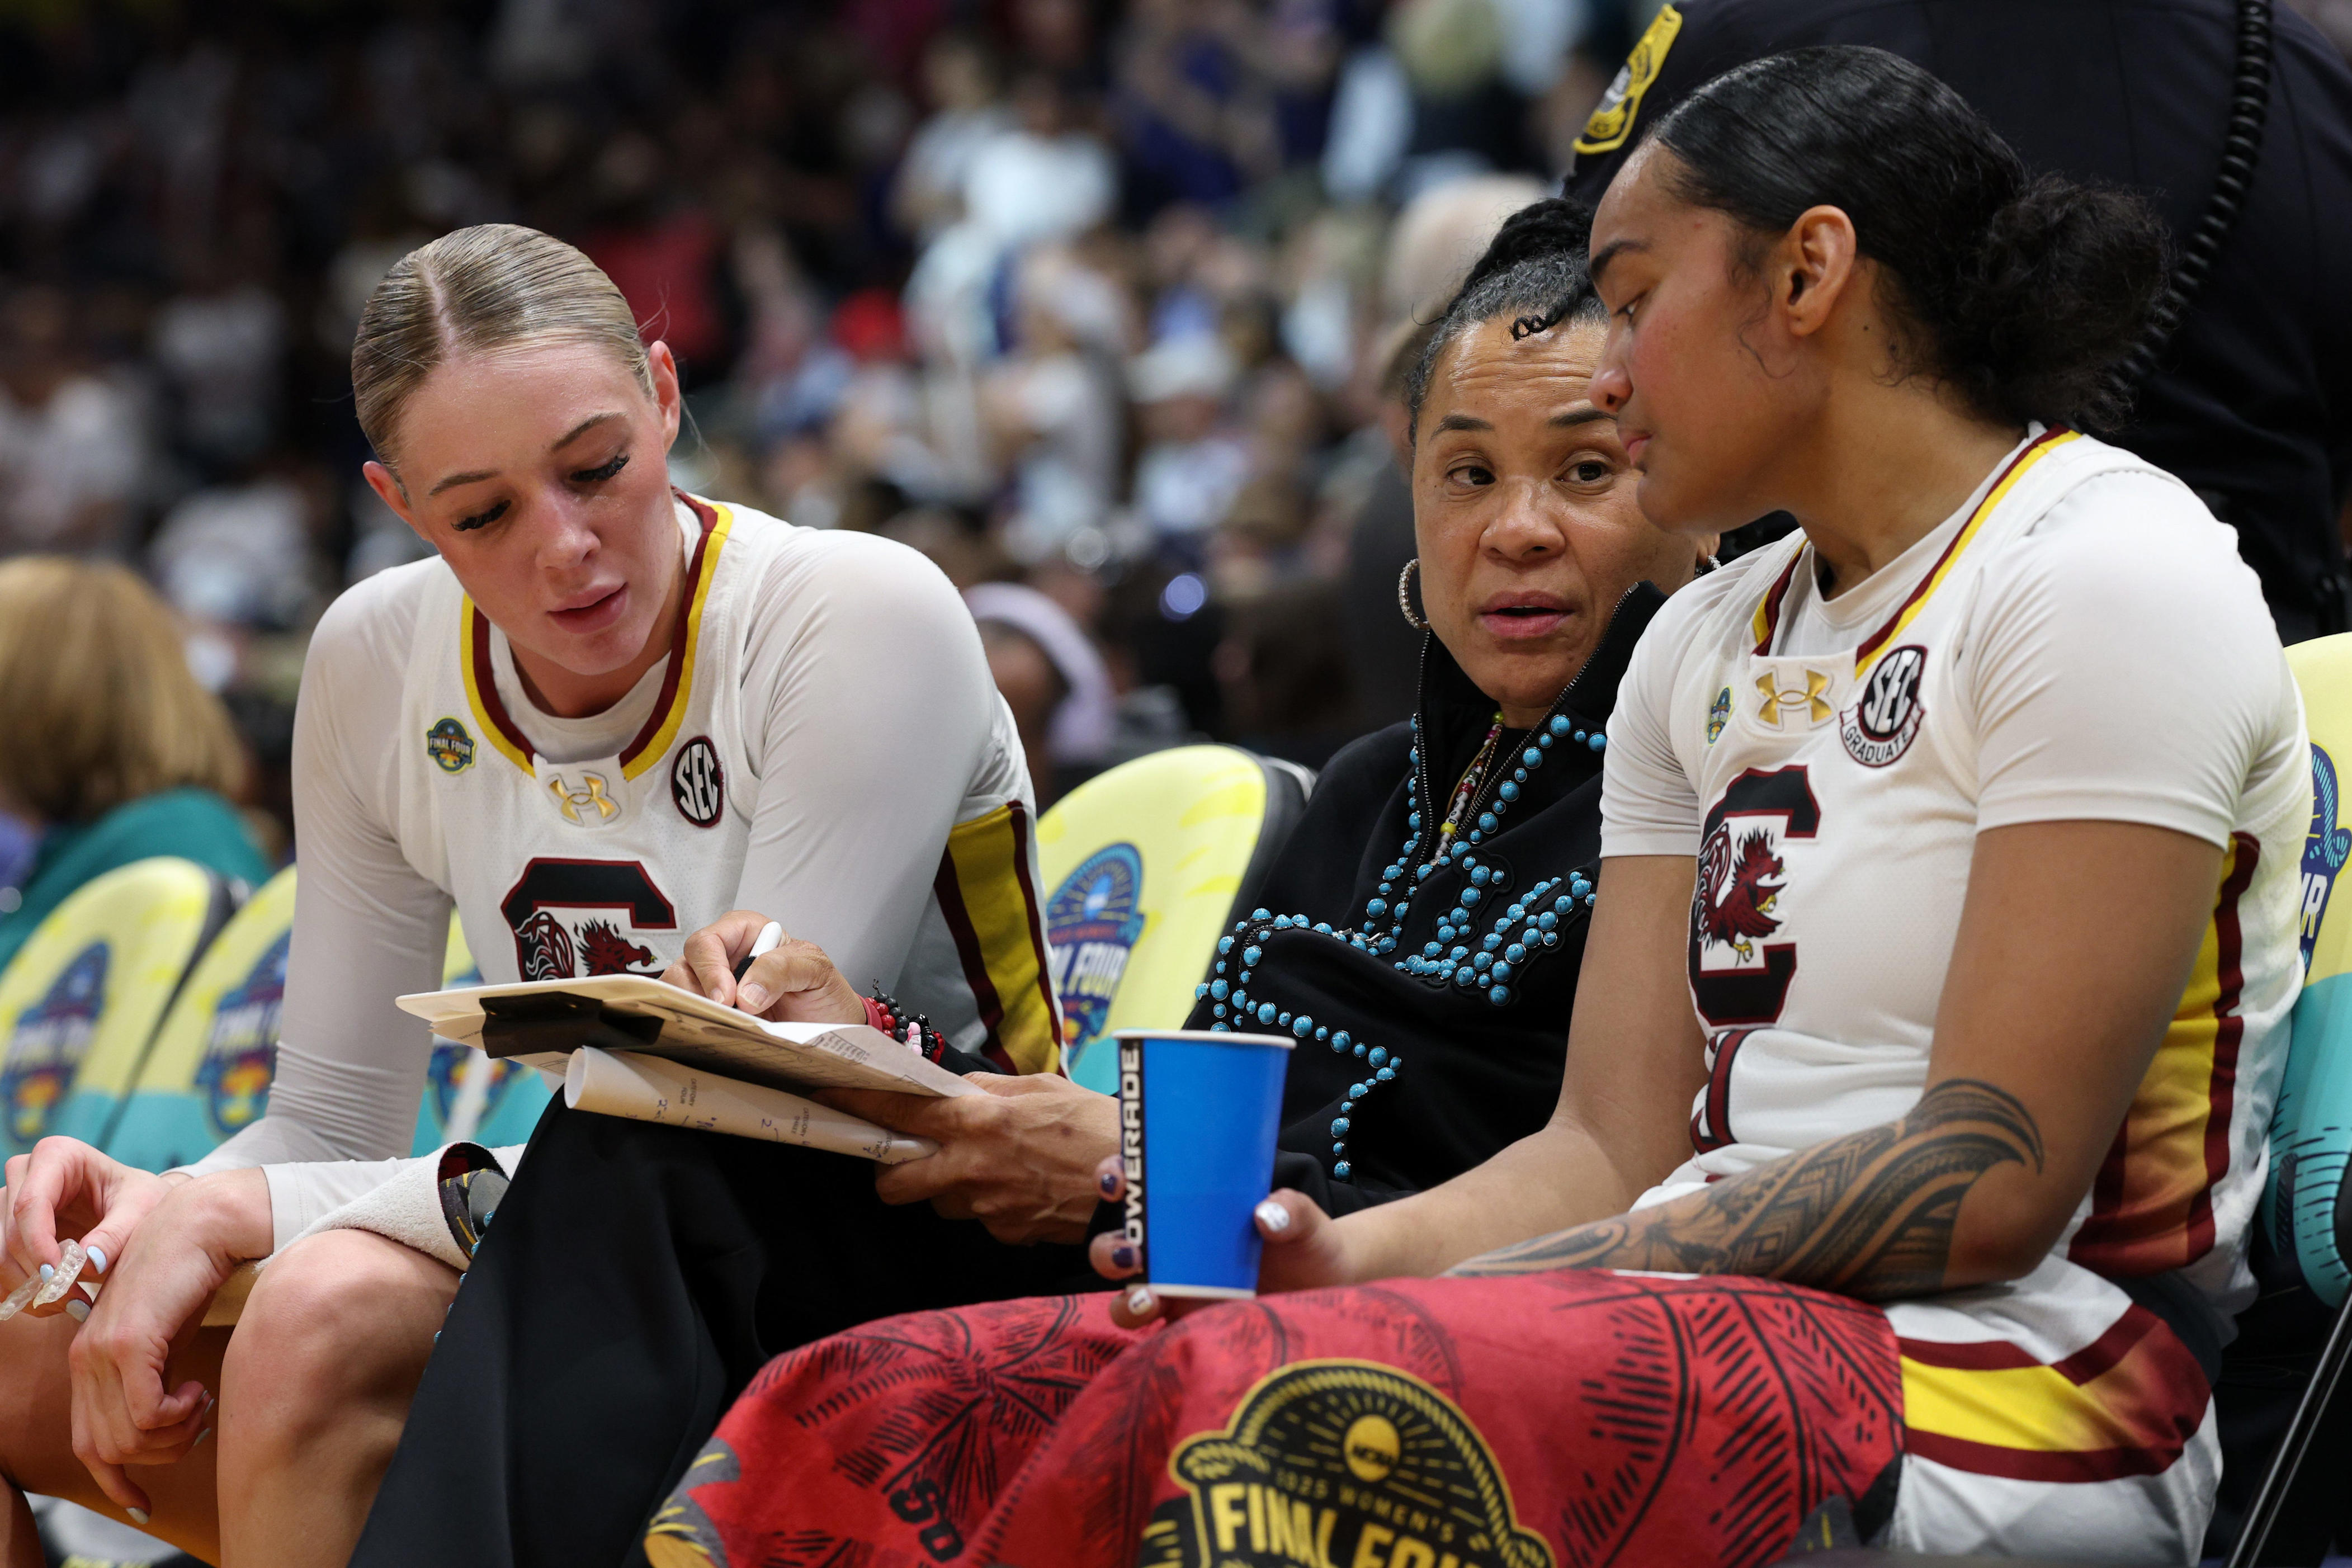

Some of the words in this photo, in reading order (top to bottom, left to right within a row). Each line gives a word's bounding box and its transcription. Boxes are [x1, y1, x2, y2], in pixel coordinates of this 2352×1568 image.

[1864, 649, 1921, 733] SEC
[429, 738, 449, 749] FINAL
[451, 739, 471, 756] FOUR
[676, 743, 719, 821] SEC
[1845, 726, 1909, 762] GRADUATE
[1121, 1047, 1144, 1247] OWERADE
[1210, 1482, 1340, 1568] FINAL
[1339, 1485, 1456, 1543] WOMEN'S
